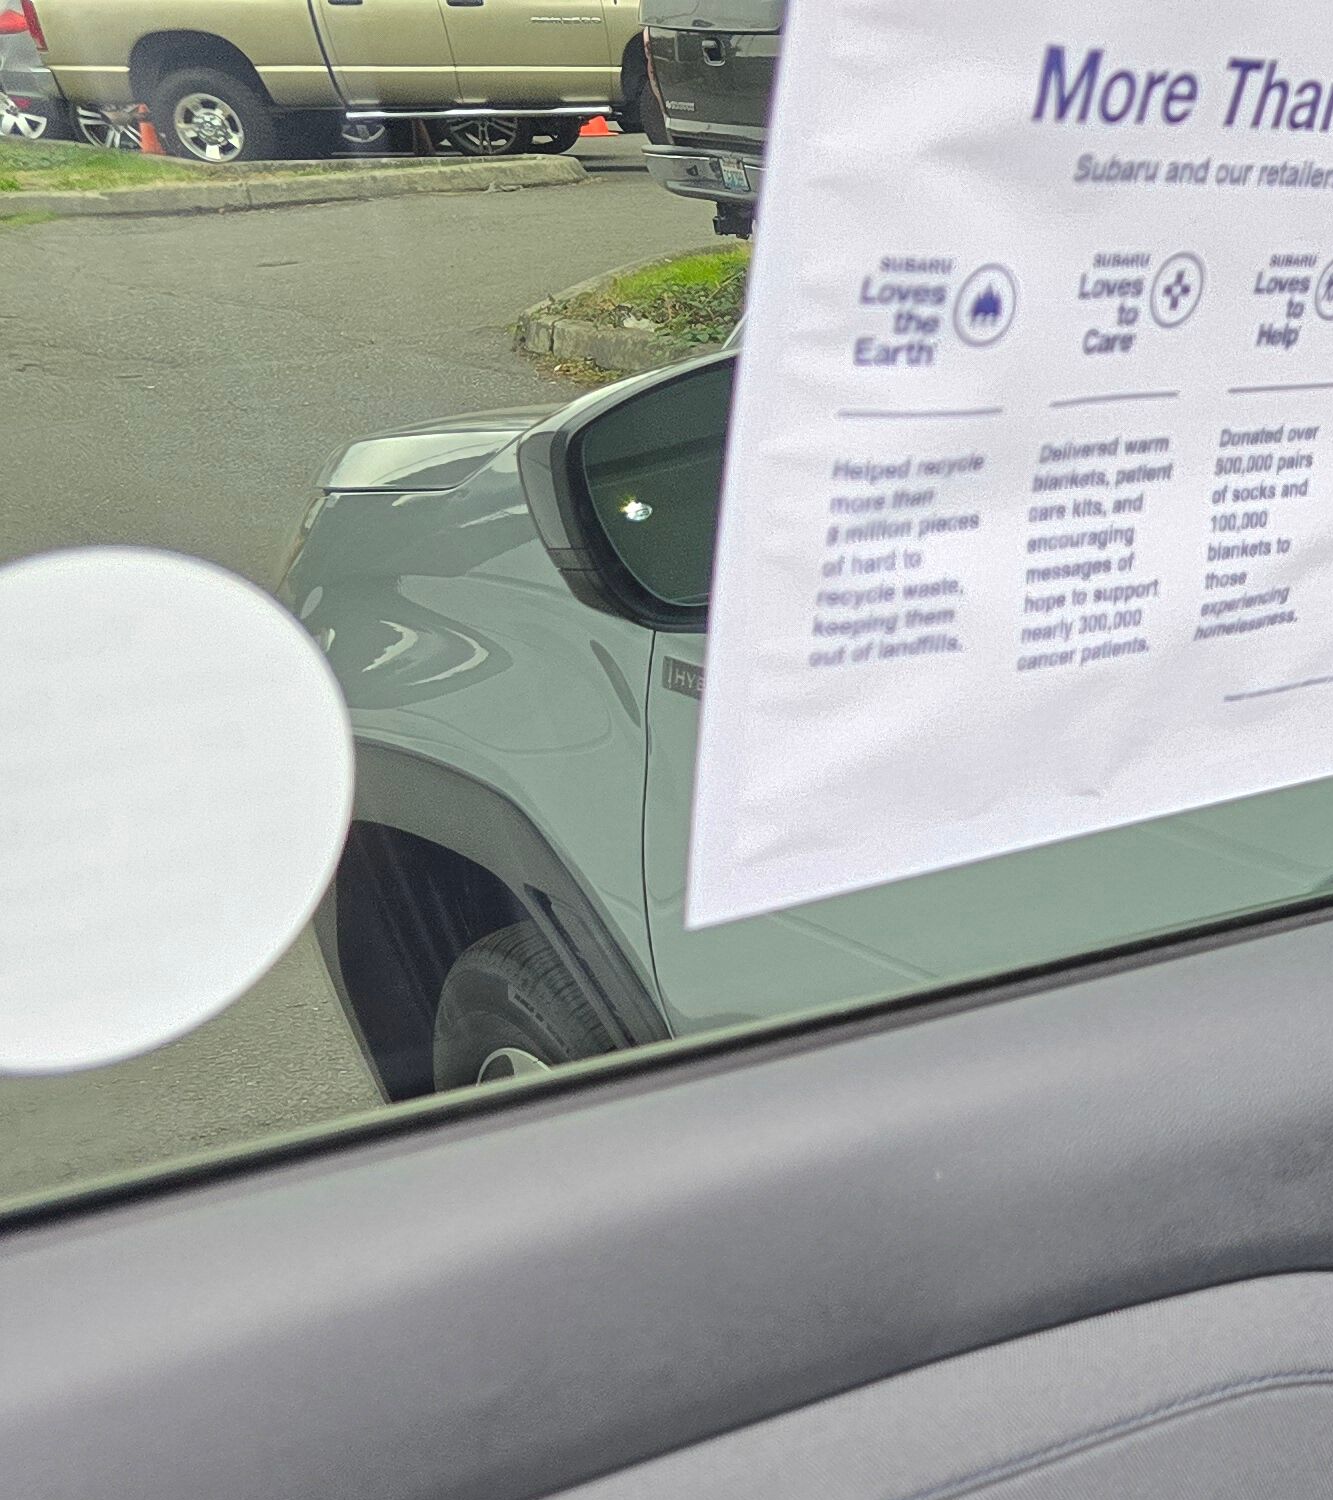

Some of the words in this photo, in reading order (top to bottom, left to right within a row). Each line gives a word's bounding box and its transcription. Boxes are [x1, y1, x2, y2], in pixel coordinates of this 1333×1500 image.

[1032, 43, 1199, 126] More
[1073, 153, 1159, 183] Subaru
[1164, 157, 1210, 185] and
[1215, 162, 1253, 186] our
[879, 256, 954, 275] SUBARU
[1092, 252, 1150, 269] SUBARU
[1269, 253, 1317, 268] SUBARU
[859, 275, 947, 305] Loves
[1078, 272, 1144, 300] Loves
[1253, 271, 1311, 295] Loves
[893, 307, 940, 336] the
[1117, 301, 1139, 327] to
[1285, 297, 1305, 320] to
[1082, 328, 1135, 356] Care
[1255, 322, 1300, 350] Help
[853, 336, 934, 367] Earth
[1039, 436, 1119, 464] Delivered
[1124, 437, 1170, 455] warm
[1219, 424, 1284, 448] Donated
[1287, 424, 1320, 443] over
[832, 458, 911, 485] Helped
[1276, 449, 1314, 476] pairs
[1032, 470, 1109, 493] blankets,
[1115, 462, 1173, 489] patient
[1212, 484, 1228, 505] of
[1232, 479, 1276, 502] socks
[1281, 478, 1309, 498] and
[892, 489, 935, 510] than
[1028, 502, 1066, 522] care
[1072, 498, 1107, 518] kits,
[1112, 493, 1144, 515] and
[1210, 509, 1268, 533] 100,000
[1026, 524, 1135, 554] encouraging
[1207, 539, 1271, 562] blankets
[1276, 536, 1291, 554] to
[1026, 558, 1112, 584] messages
[1117, 552, 1134, 573] of
[1204, 571, 1247, 590] those
[1024, 592, 1066, 614] hope
[1072, 587, 1088, 606] to
[1093, 578, 1159, 606] support
[1201, 587, 1290, 618] experiencing
[1021, 618, 1073, 643] nearly
[1017, 649, 1075, 672] cancer
[1080, 636, 1149, 667] patients.
